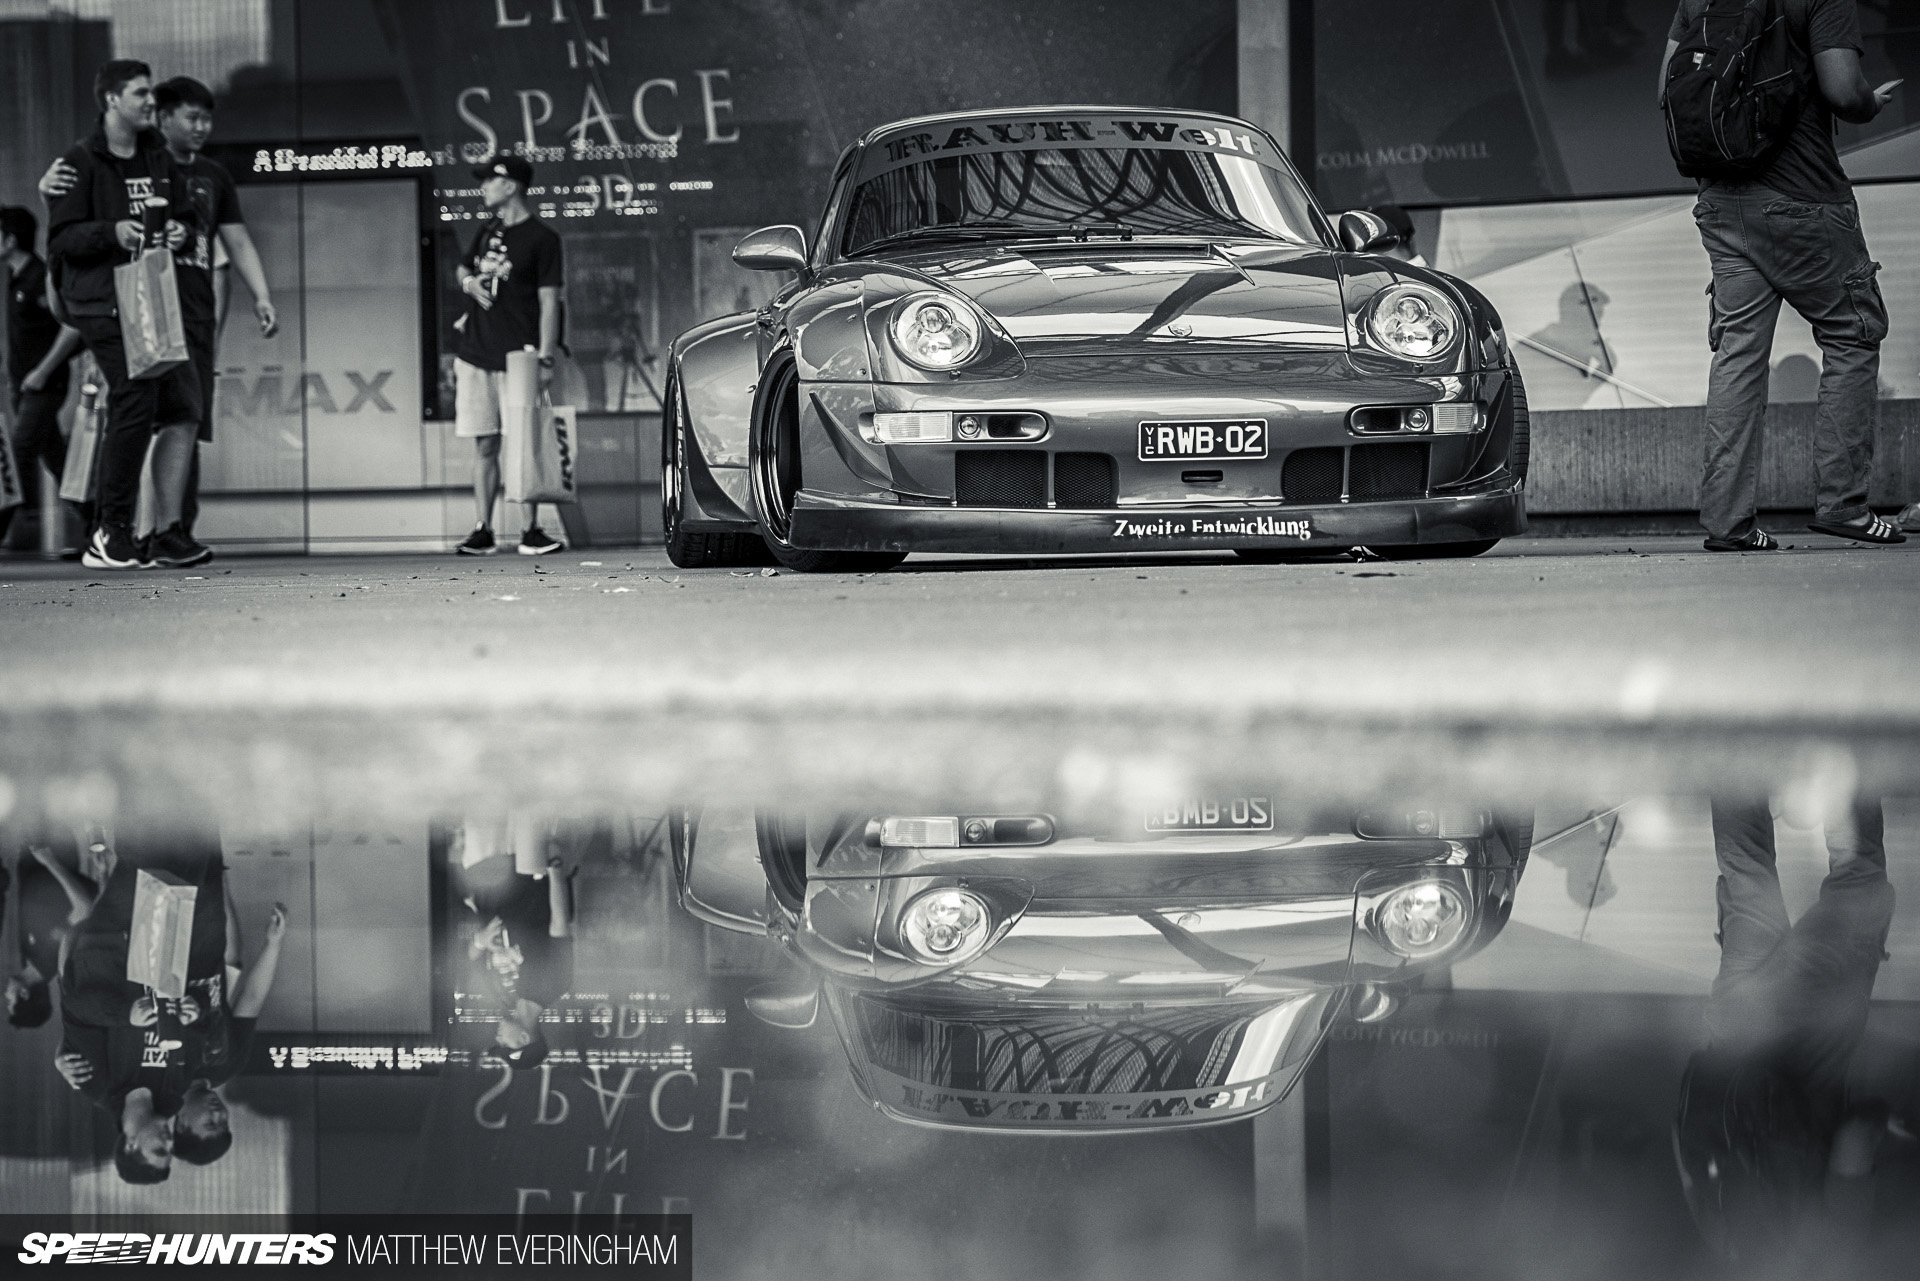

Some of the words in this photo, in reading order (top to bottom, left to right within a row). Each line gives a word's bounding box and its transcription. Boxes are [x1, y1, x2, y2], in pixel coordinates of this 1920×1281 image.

[567, 36, 610, 69] IN
[456, 68, 741, 163] SPACE
[885, 120, 1260, 162] RAUH-Welt
[577, 173, 635, 210] 3D
[217, 370, 396, 417] MAX
[1113, 518, 1186, 539] Zweite
[1191, 516, 1312, 541] Entwicklung
